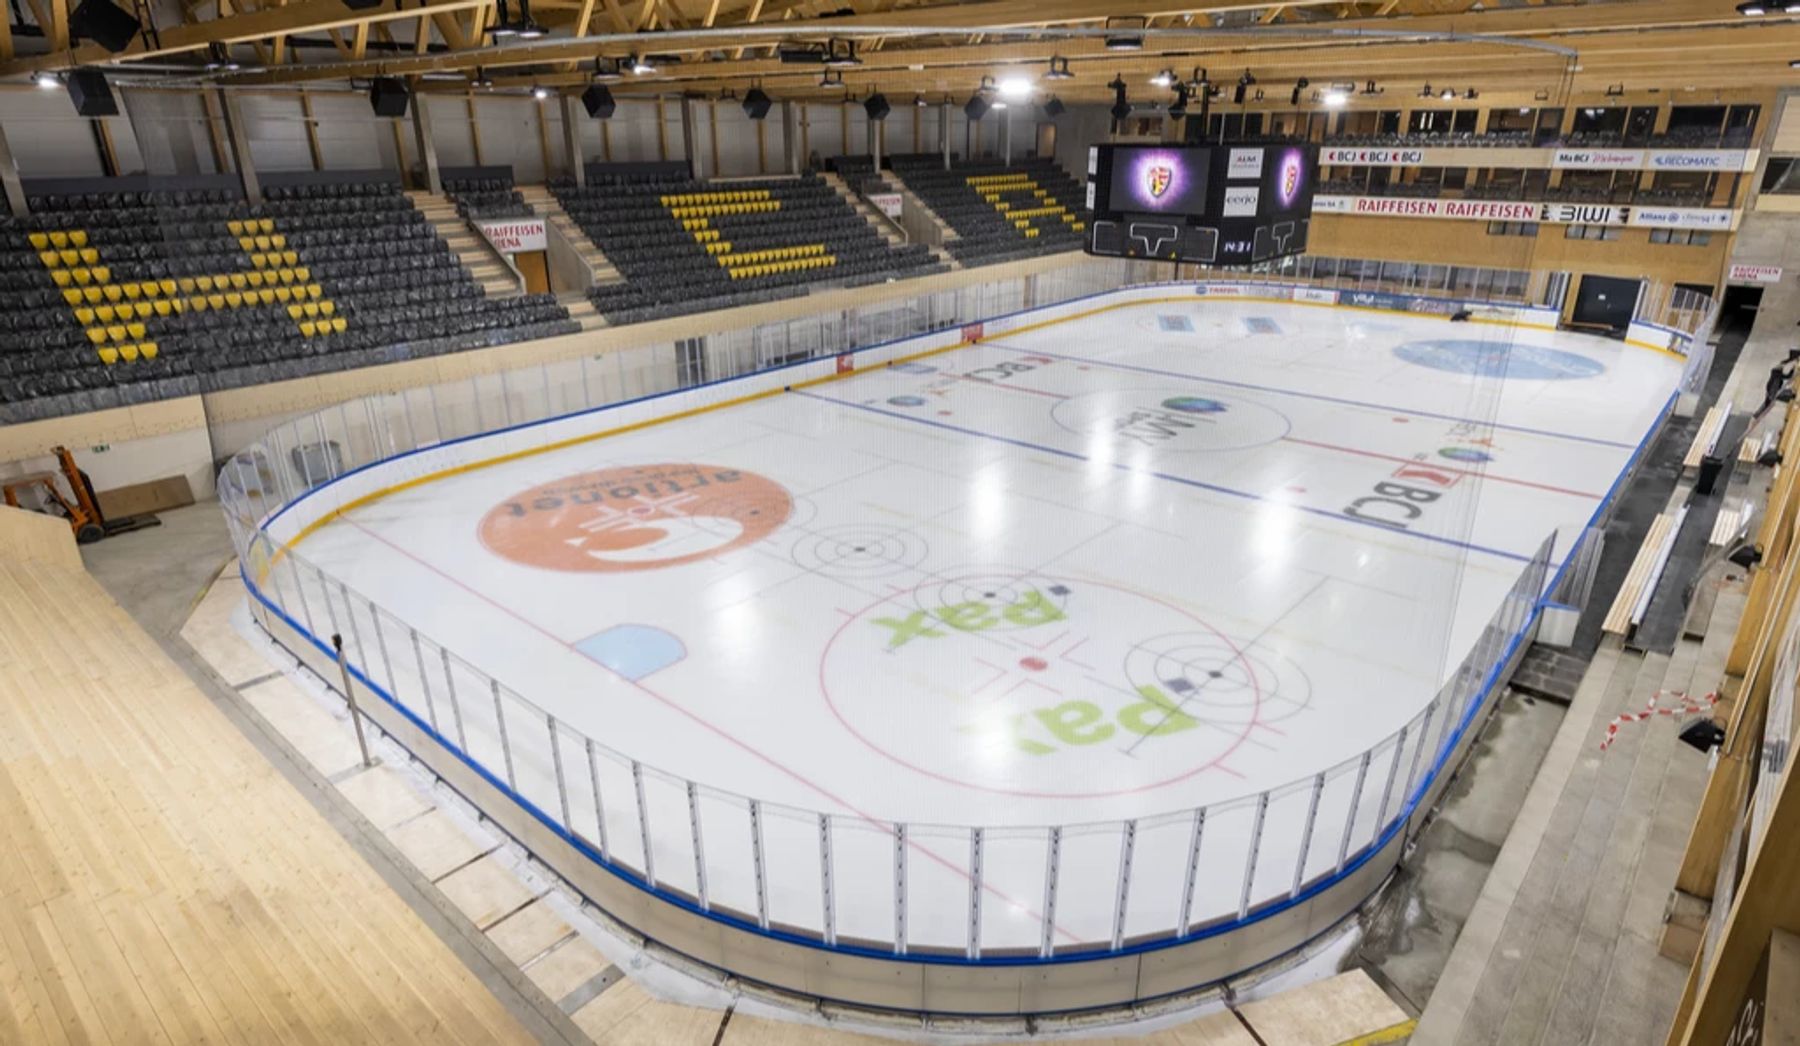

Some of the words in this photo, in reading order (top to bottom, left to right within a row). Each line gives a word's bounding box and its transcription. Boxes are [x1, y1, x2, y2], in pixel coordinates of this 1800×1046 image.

[1337, 151, 1357, 162] BCJ
[1369, 151, 1389, 162] BCJ
[1401, 151, 1422, 162] BCJ
[1357, 198, 1438, 215] RAIFFEISEN
[1445, 202, 1535, 218] RAIFFEISEN
[1560, 205, 1611, 222] BIWI
[484, 224, 543, 237] RAIFFEISEN
[1342, 480, 1443, 530] BCJ
[868, 589, 1068, 648] pax
